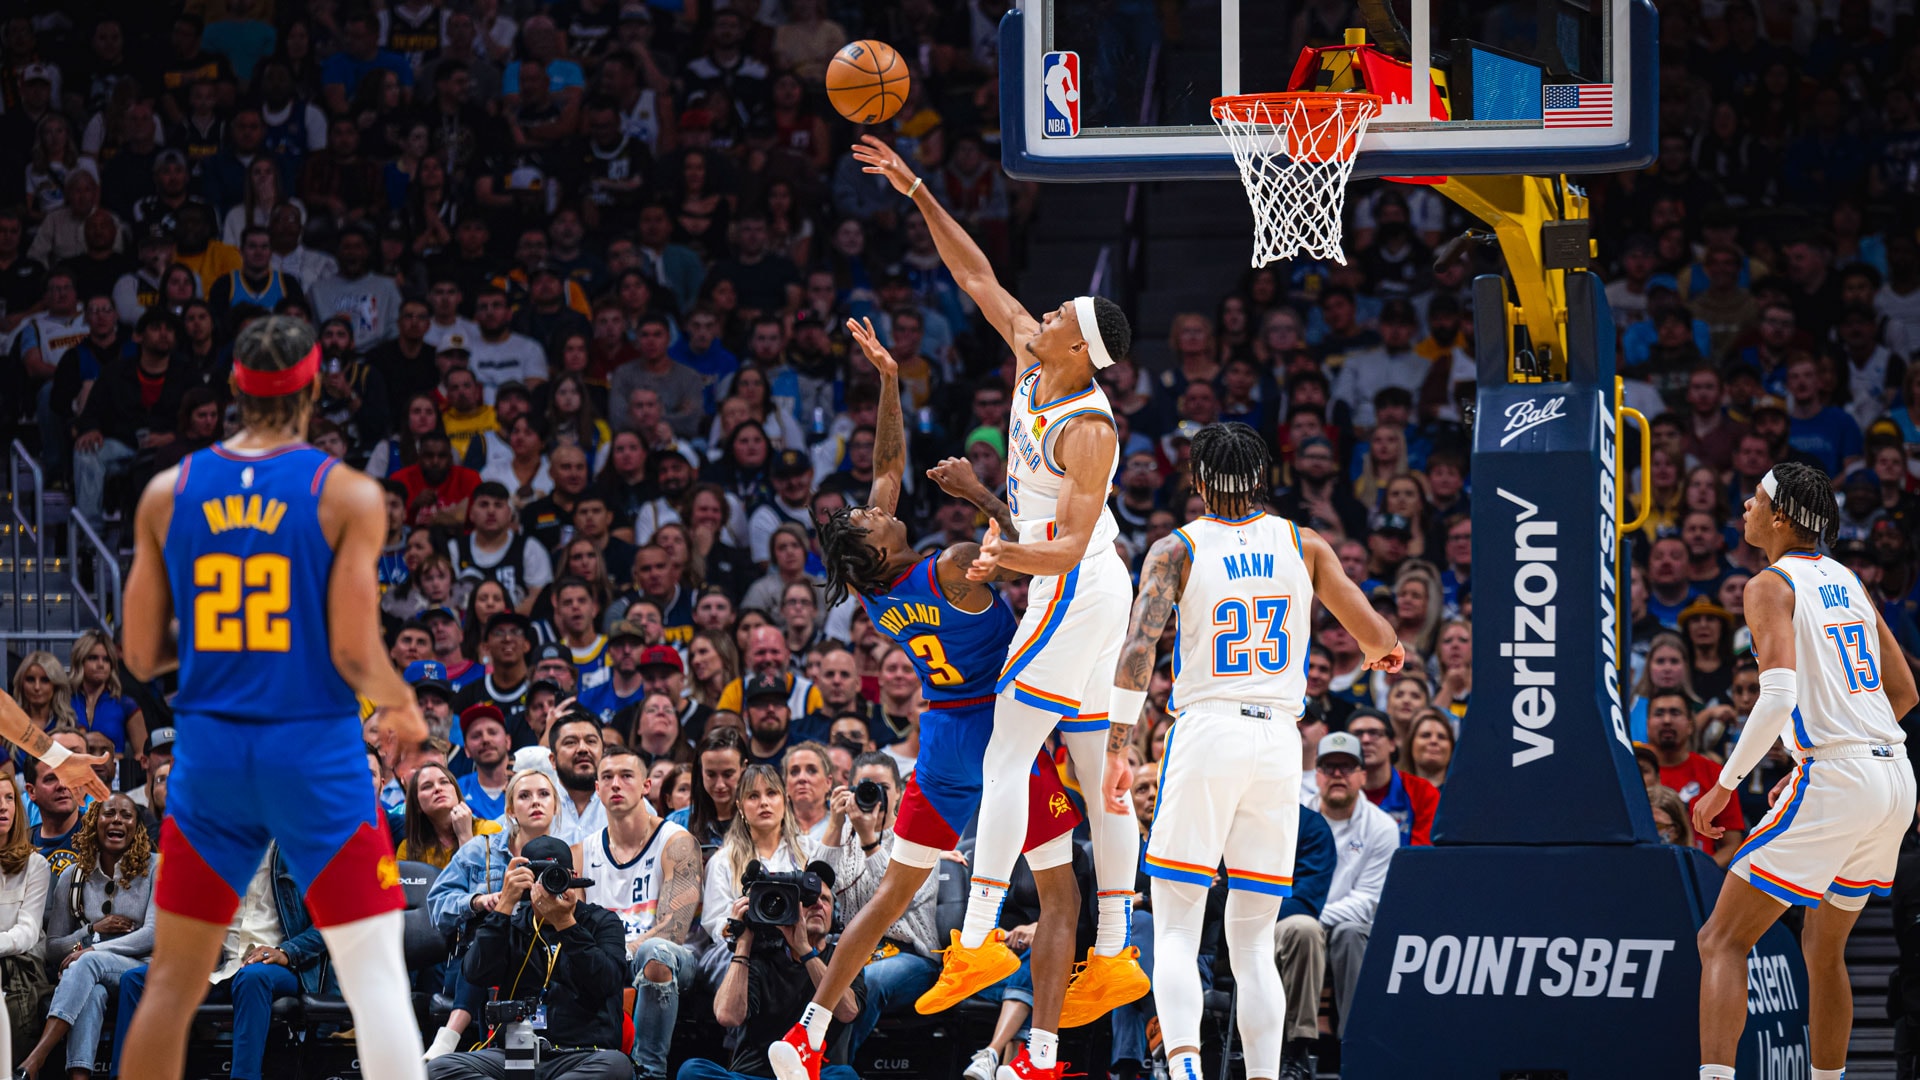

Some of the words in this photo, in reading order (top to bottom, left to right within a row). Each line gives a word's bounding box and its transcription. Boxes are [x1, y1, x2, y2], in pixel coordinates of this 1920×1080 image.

[1048, 118, 1066, 133] NBA
[1500, 396, 1567, 447] Ball
[1223, 552, 1274, 580] MANN
[193, 551, 292, 653] 22
[879, 602, 941, 635] HYLAND
[1818, 584, 1849, 609] DIENG
[908, 634, 965, 686] 3
[1212, 595, 1291, 677] 23
[1499, 520, 1558, 767] verizon
[1823, 619, 1882, 694] 13
[397, 877, 427, 885] XUS
[632, 873, 651, 903] 21
[1386, 935, 1676, 999] POINTSBET
[1747, 944, 1799, 1015] estern
[874, 1058, 910, 1070] CLUB
